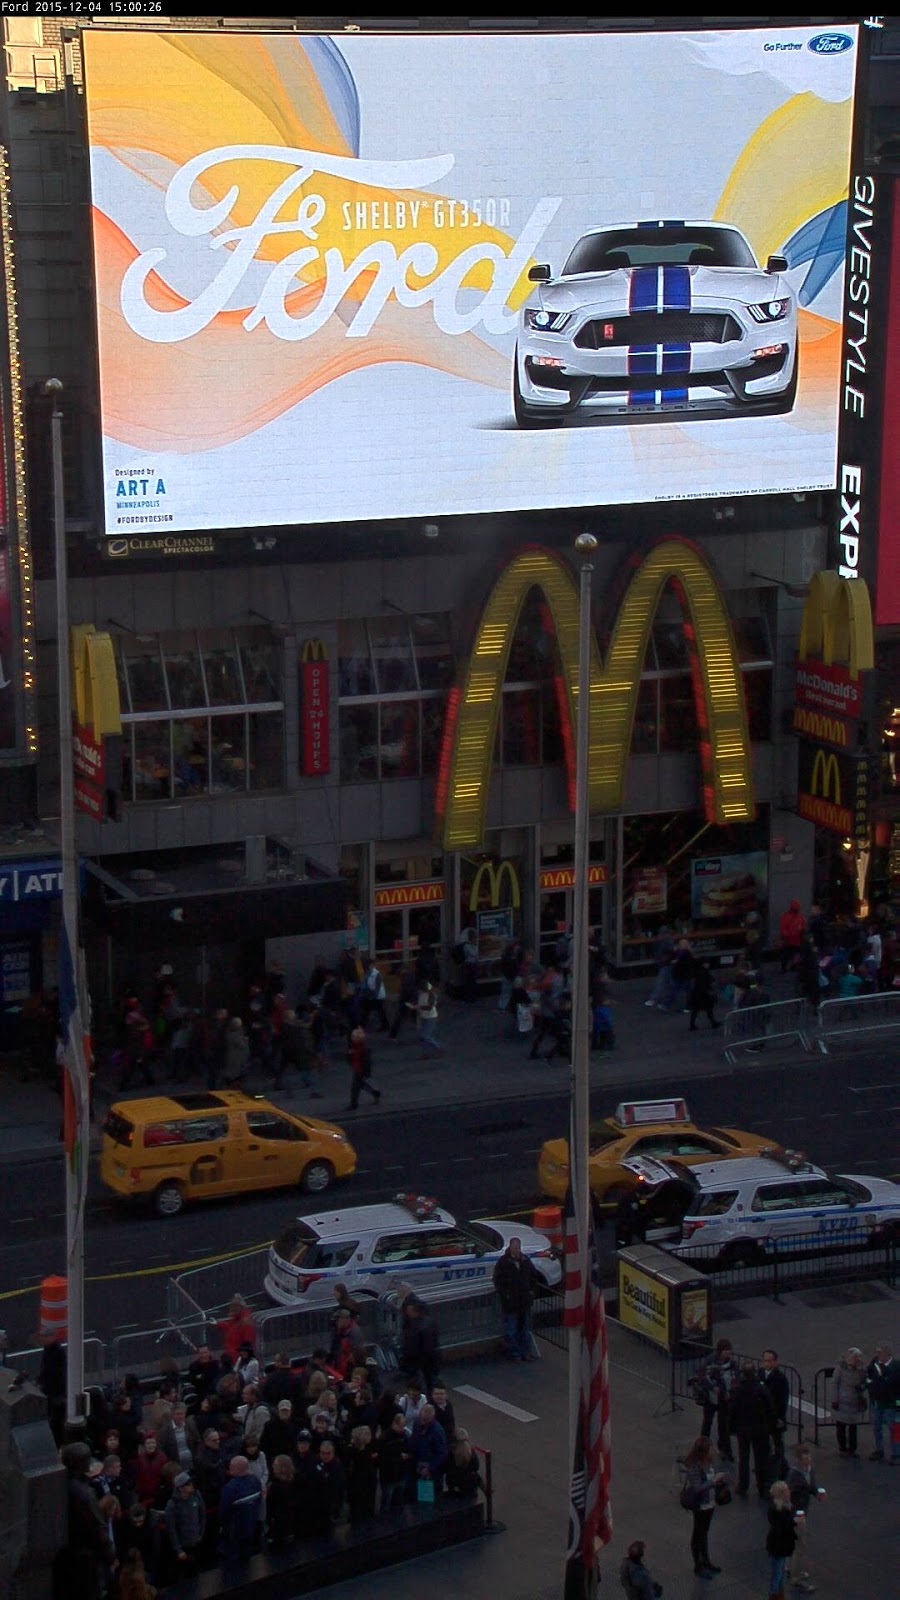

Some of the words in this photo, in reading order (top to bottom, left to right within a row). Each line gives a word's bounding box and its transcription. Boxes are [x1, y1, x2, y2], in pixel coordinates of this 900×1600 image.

[342, 200, 419, 231] SHELBY
[434, 198, 511, 228] GT350R
[120, 144, 562, 343] Ford
[116, 479, 149, 497] ART
[155, 478, 166, 495] A
[116, 500, 160, 509] MINNEAPOLIS
[797, 670, 858, 701] McDonald's
